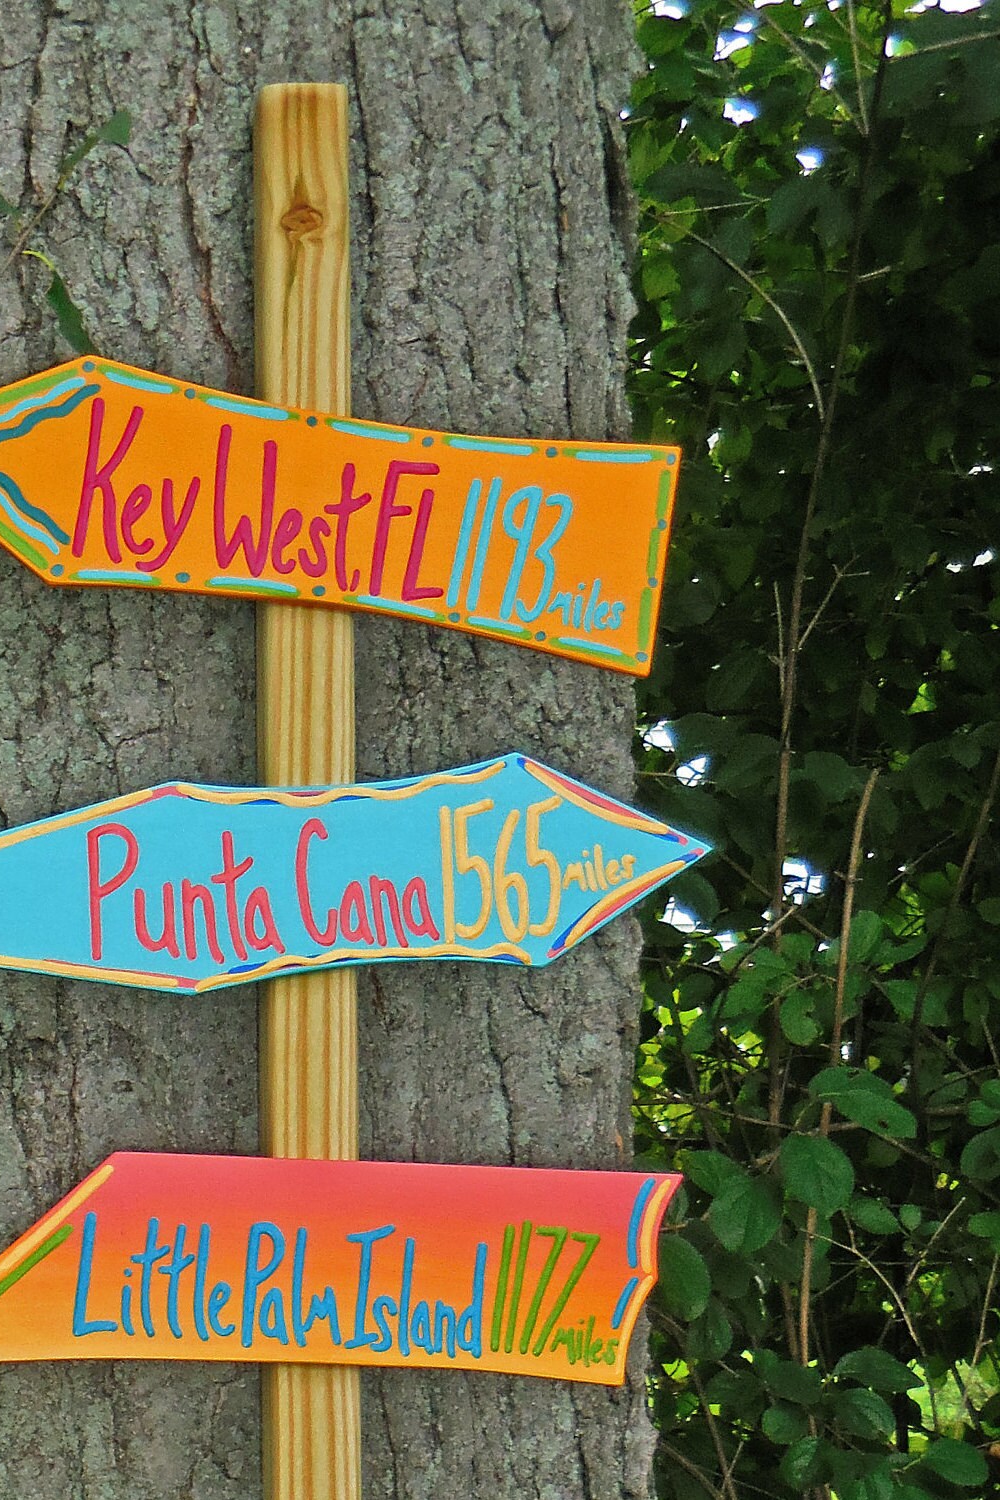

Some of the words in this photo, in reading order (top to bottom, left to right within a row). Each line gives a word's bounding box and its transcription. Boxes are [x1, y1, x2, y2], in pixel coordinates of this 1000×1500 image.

[71, 397, 201, 572] Key
[368, 460, 445, 601] FL
[446, 476, 574, 623] 1193
[546, 577, 626, 632] miles
[86, 822, 286, 964] Punta
[294, 817, 441, 948] Cana
[438, 797, 563, 945] 1565
[561, 843, 637, 893] miles
[72, 1211, 237, 1342] Little
[240, 1220, 343, 1349] Palm
[344, 1223, 489, 1358] Island
[489, 1220, 602, 1356] 1177
[551, 1314, 620, 1367] miles
